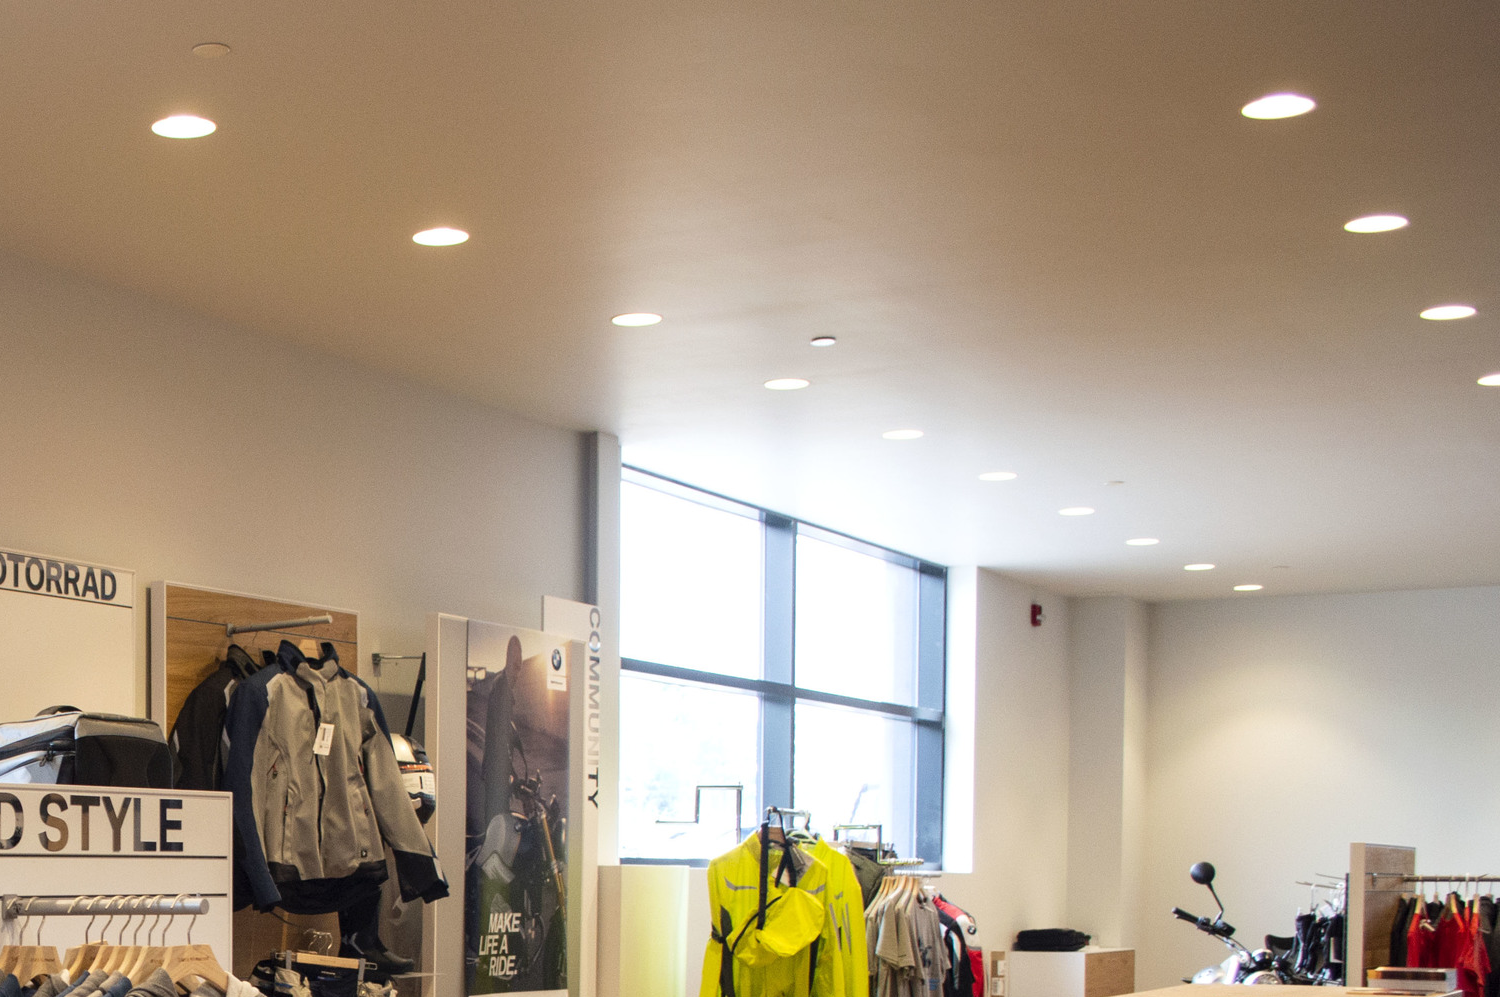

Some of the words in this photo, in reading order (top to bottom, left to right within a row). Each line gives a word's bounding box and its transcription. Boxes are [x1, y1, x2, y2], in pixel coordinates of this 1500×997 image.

[587, 607, 601, 809] COMMUNITY
[37, 793, 183, 852] STYLE
[488, 912, 522, 933] MAKE
[479, 934, 499, 955] LIFE
[499, 934, 509, 954] A
[489, 955, 518, 976] RIDE.
